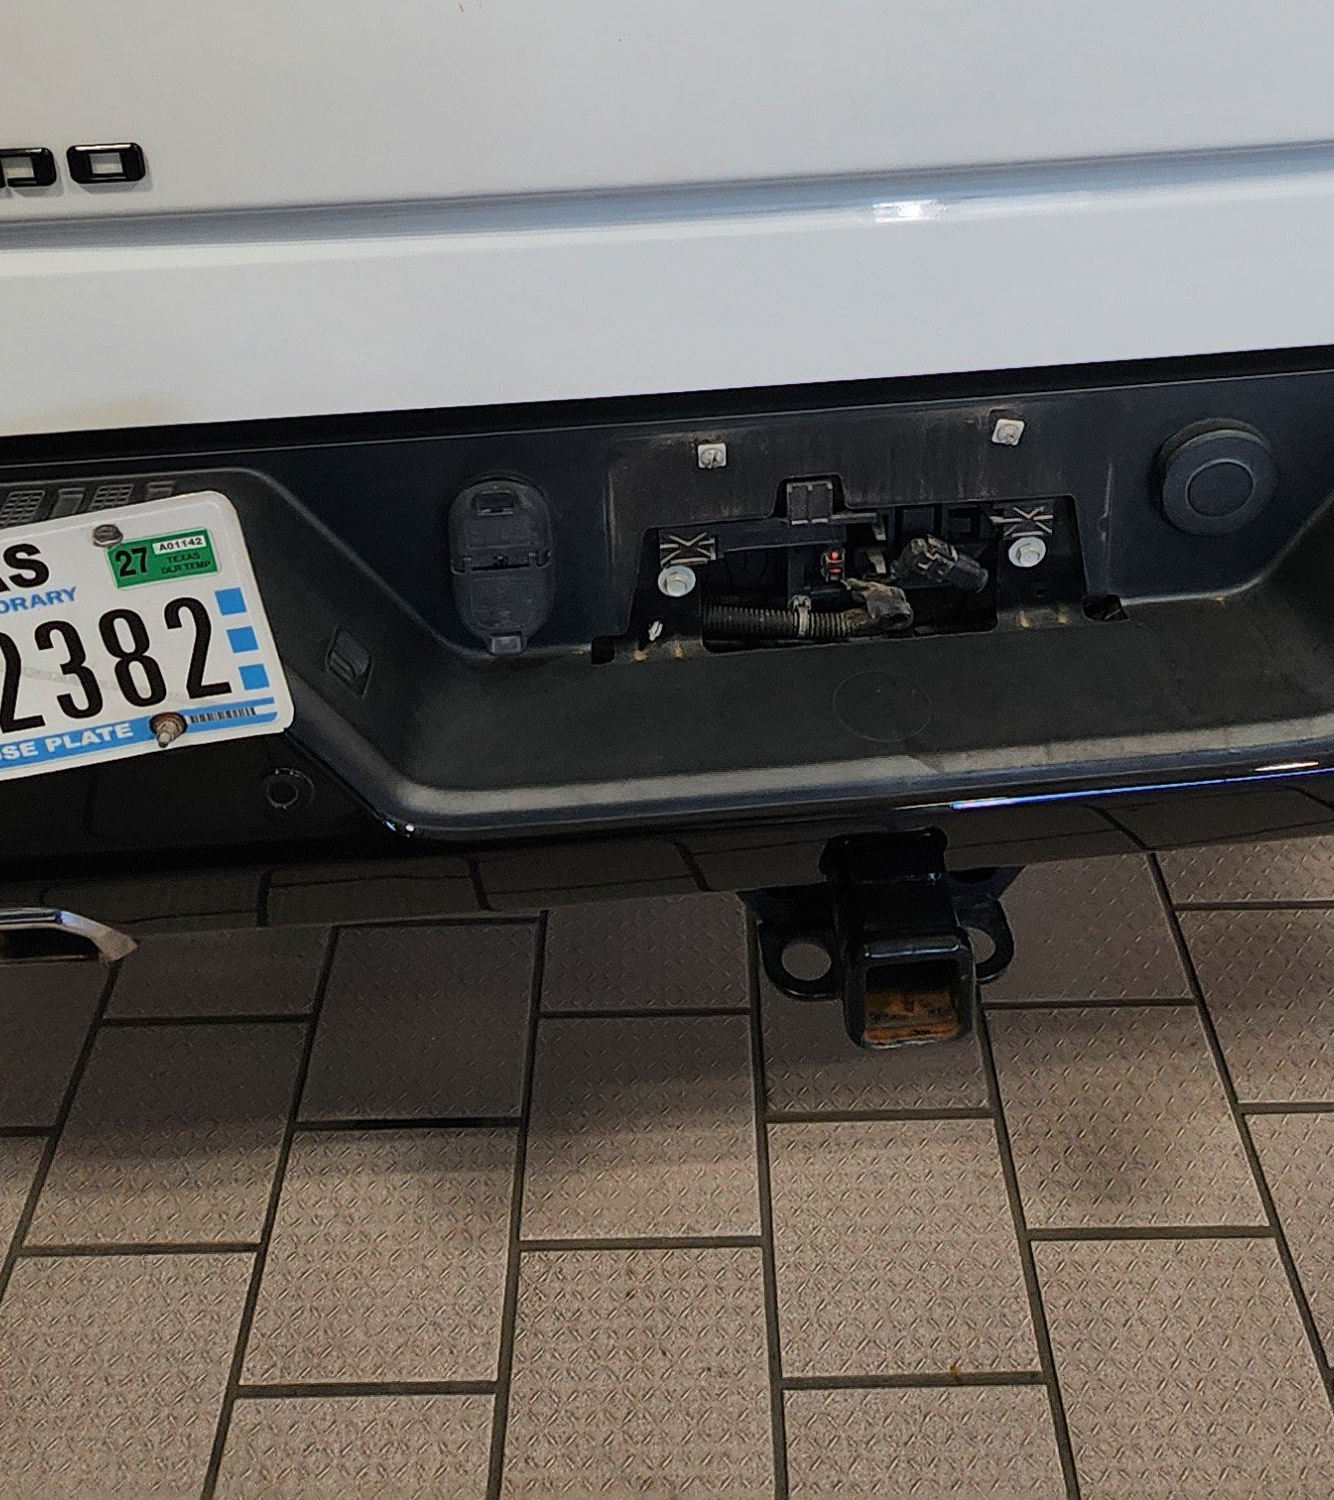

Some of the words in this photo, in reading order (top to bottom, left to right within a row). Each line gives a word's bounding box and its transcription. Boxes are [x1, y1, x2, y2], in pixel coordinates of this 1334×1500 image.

[159, 537, 204, 552] A01142
[115, 546, 148, 578] 27
[166, 551, 201, 563] TEXAS
[184, 560, 211, 571] TEMP
[44, 722, 134, 753] PLATE
